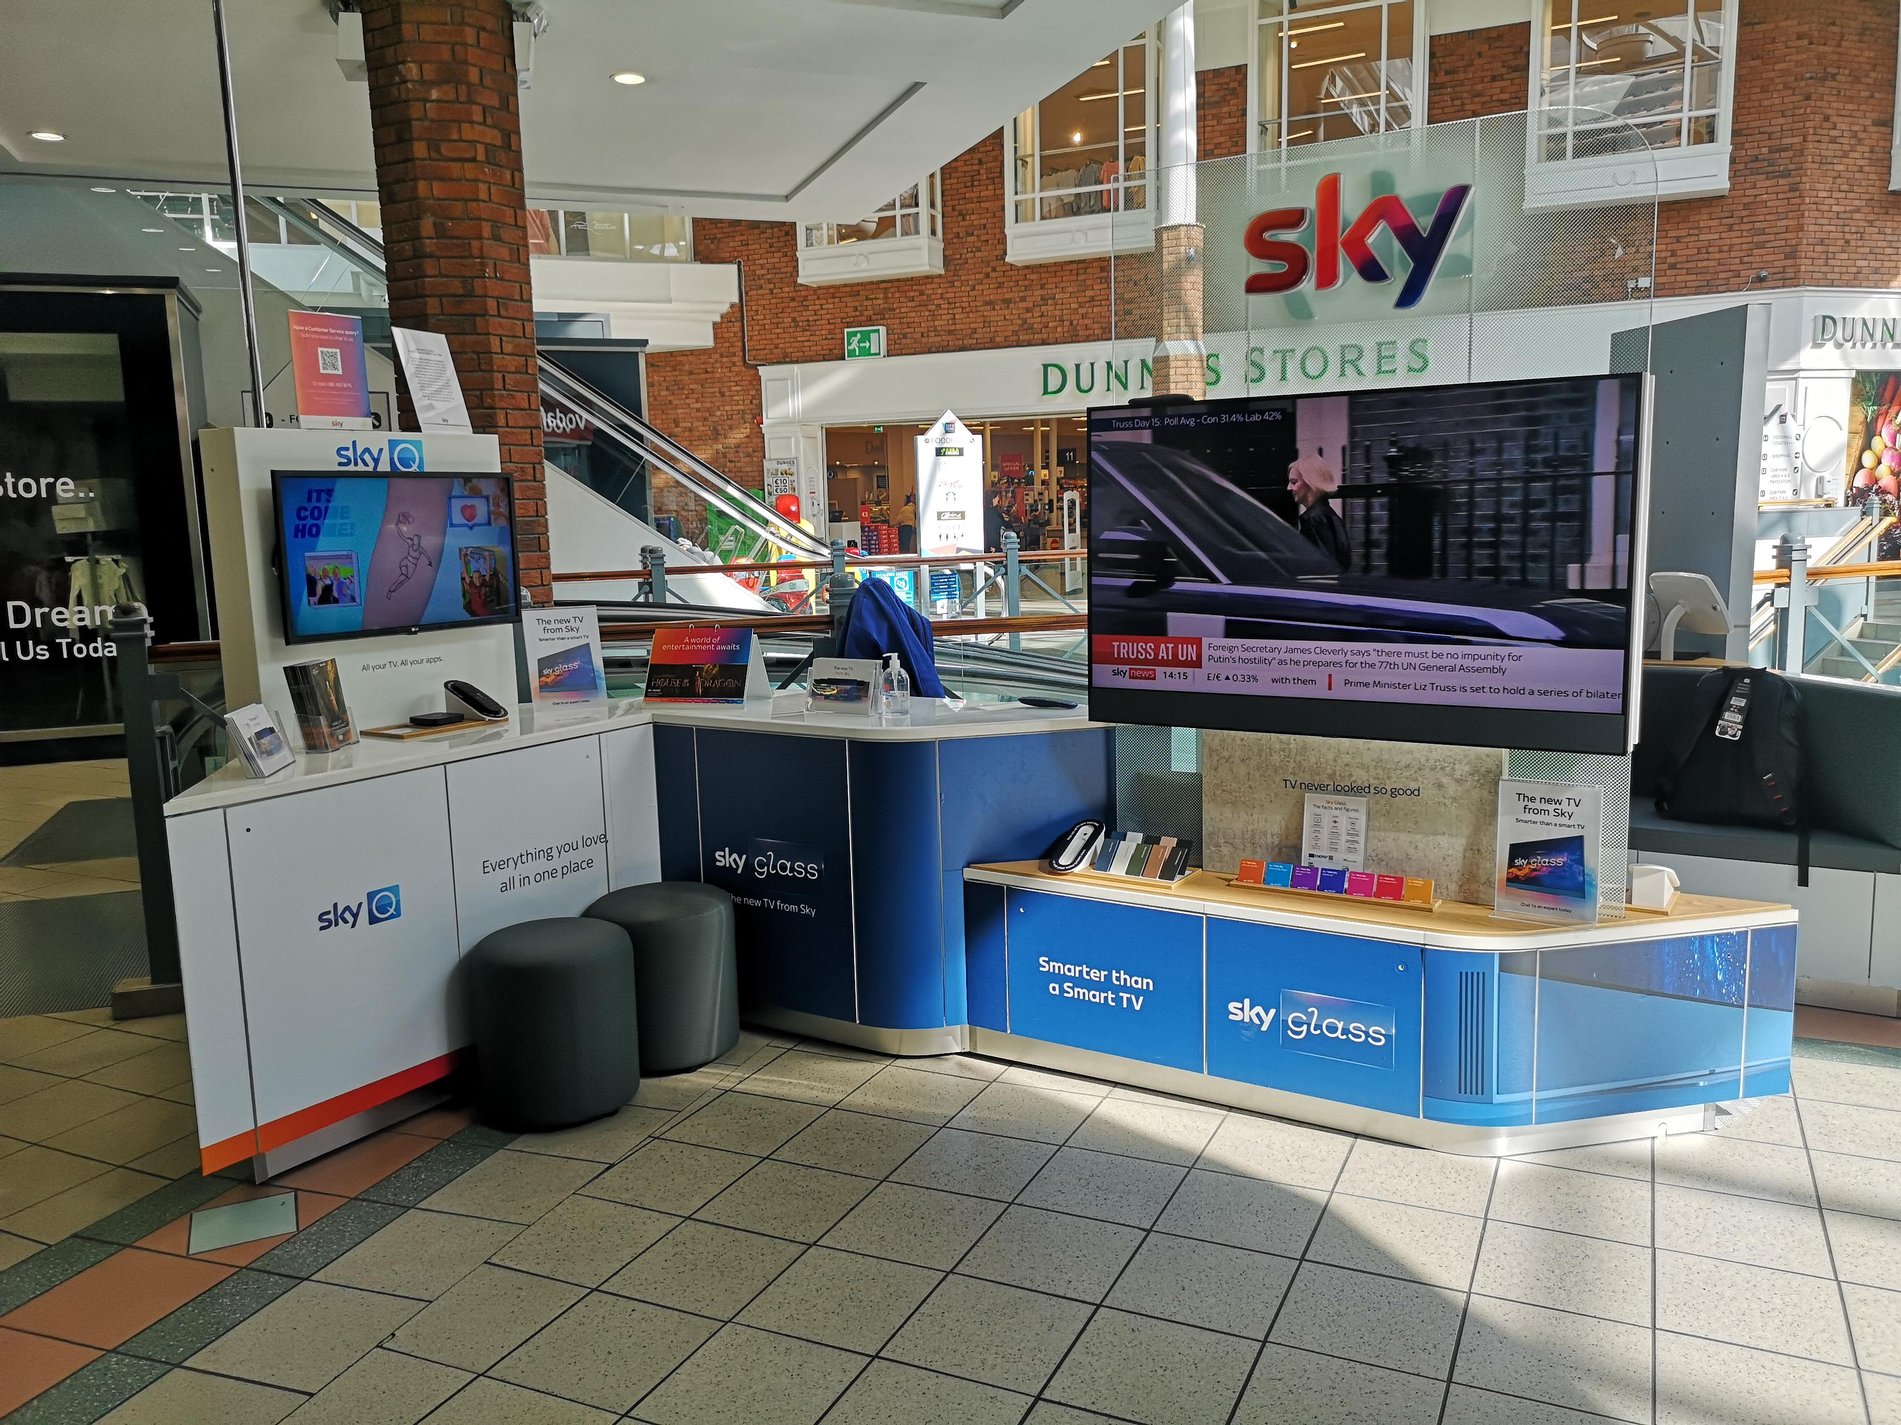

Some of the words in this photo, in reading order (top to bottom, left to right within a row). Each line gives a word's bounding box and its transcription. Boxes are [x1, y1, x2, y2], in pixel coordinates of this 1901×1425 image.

[1244, 172, 1475, 309] sky
[1819, 315, 1896, 343] DUNN
[1041, 354, 1223, 397] DUNNS
[1247, 338, 1432, 385] STORES
[331, 419, 344, 428] sky
[1112, 419, 1133, 430] Truss
[1134, 419, 1150, 430] Day
[1151, 418, 1162, 427] 15:
[1164, 416, 1179, 426] Poll
[1180, 416, 1196, 428] Avg
[1201, 415, 1219, 424] Con
[1220, 414, 1244, 423] 31.4%
[1245, 412, 1262, 422] Lab
[1262, 411, 1282, 421] 42%
[336, 440, 384, 471] sky
[1066, 452, 1074, 461] 11
[0, 472, 95, 499] tore..
[536, 618, 552, 626] The
[572, 616, 584, 624] TV
[543, 626, 564, 634] from
[565, 626, 580, 634] Sky
[16, 640, 50, 661] Us
[55, 637, 118, 659] Toda
[1112, 642, 1155, 660] TRUSS
[1158, 642, 1174, 660] AT
[1178, 644, 1197, 661] UN
[1208, 642, 1239, 654] Foreign
[1241, 644, 1282, 655] Secretary
[1283, 645, 1312, 655] James
[1313, 646, 1348, 658] Cleverly
[1350, 650, 1371, 660] says
[1373, 648, 1402, 659] "there
[1404, 650, 1430, 660] must
[1432, 650, 1444, 660] be
[1446, 652, 1459, 660] no
[1461, 651, 1506, 664] impunity
[1507, 652, 1523, 662] for
[362, 664, 370, 672] All
[372, 662, 387, 672] your
[388, 660, 400, 669] TV.
[400, 658, 408, 666] All
[409, 657, 424, 667] your
[426, 655, 445, 664] apps.
[542, 668, 554, 676] sky
[554, 662, 579, 675] glass
[1112, 668, 1128, 679] sky
[1130, 669, 1155, 679] news
[1208, 654, 1237, 664] Putin's
[1238, 655, 1276, 667] hostility"
[1290, 658, 1301, 666] he
[1302, 660, 1344, 669] prepares
[1345, 660, 1358, 668] for
[1360, 660, 1376, 670] the
[1378, 660, 1400, 671] 77th
[1401, 662, 1416, 671] UN
[1418, 662, 1456, 673] General
[1458, 663, 1507, 676] Assembly
[1162, 670, 1188, 680] 14:15
[1232, 674, 1259, 683] 0.33%
[1271, 676, 1292, 685] with
[1293, 676, 1317, 686] them
[1344, 678, 1370, 689] Prime
[1372, 680, 1412, 690] Minister
[1414, 682, 1428, 691] Liz
[1429, 683, 1457, 692] Truss
[1460, 684, 1468, 693] is
[1470, 685, 1488, 694] set
[1489, 686, 1500, 694] to
[1503, 686, 1526, 696] hold
[1538, 688, 1569, 698] series
[1572, 688, 1584, 698] of
[1586, 689, 1622, 700] bilater
[1282, 778, 1298, 790] TV
[1300, 781, 1330, 792] never
[1332, 781, 1371, 794] looked
[1374, 786, 1388, 796] so
[1390, 786, 1420, 798] good
[1515, 792, 1537, 804] The
[1539, 796, 1563, 806] new
[1565, 798, 1582, 808] TV
[1515, 818, 1538, 826] Smarter
[1539, 819, 1552, 827] than
[1523, 804, 1550, 818] from
[1552, 808, 1574, 820] Sky
[482, 844, 554, 875] Everything
[555, 839, 579, 857] you
[714, 847, 747, 874] sky
[754, 851, 819, 880] glass
[1514, 857, 1528, 868] sky
[1530, 856, 1564, 868] glass
[500, 876, 516, 893] all
[518, 874, 531, 888] in
[534, 868, 558, 884] one
[561, 857, 594, 879] place
[318, 901, 363, 931] sky
[371, 891, 397, 919] Q
[729, 893, 742, 904] he
[743, 897, 762, 908] new
[762, 898, 776, 910] TV
[776, 900, 798, 914] from
[800, 904, 816, 918] Sky
[1038, 956, 1107, 983] Smarter
[1112, 969, 1154, 992] than
[1048, 984, 1060, 996] a
[1063, 982, 1116, 1006] Smart
[1120, 992, 1144, 1012] TV
[1228, 998, 1277, 1032] sky
[1287, 1007, 1387, 1047] glass
